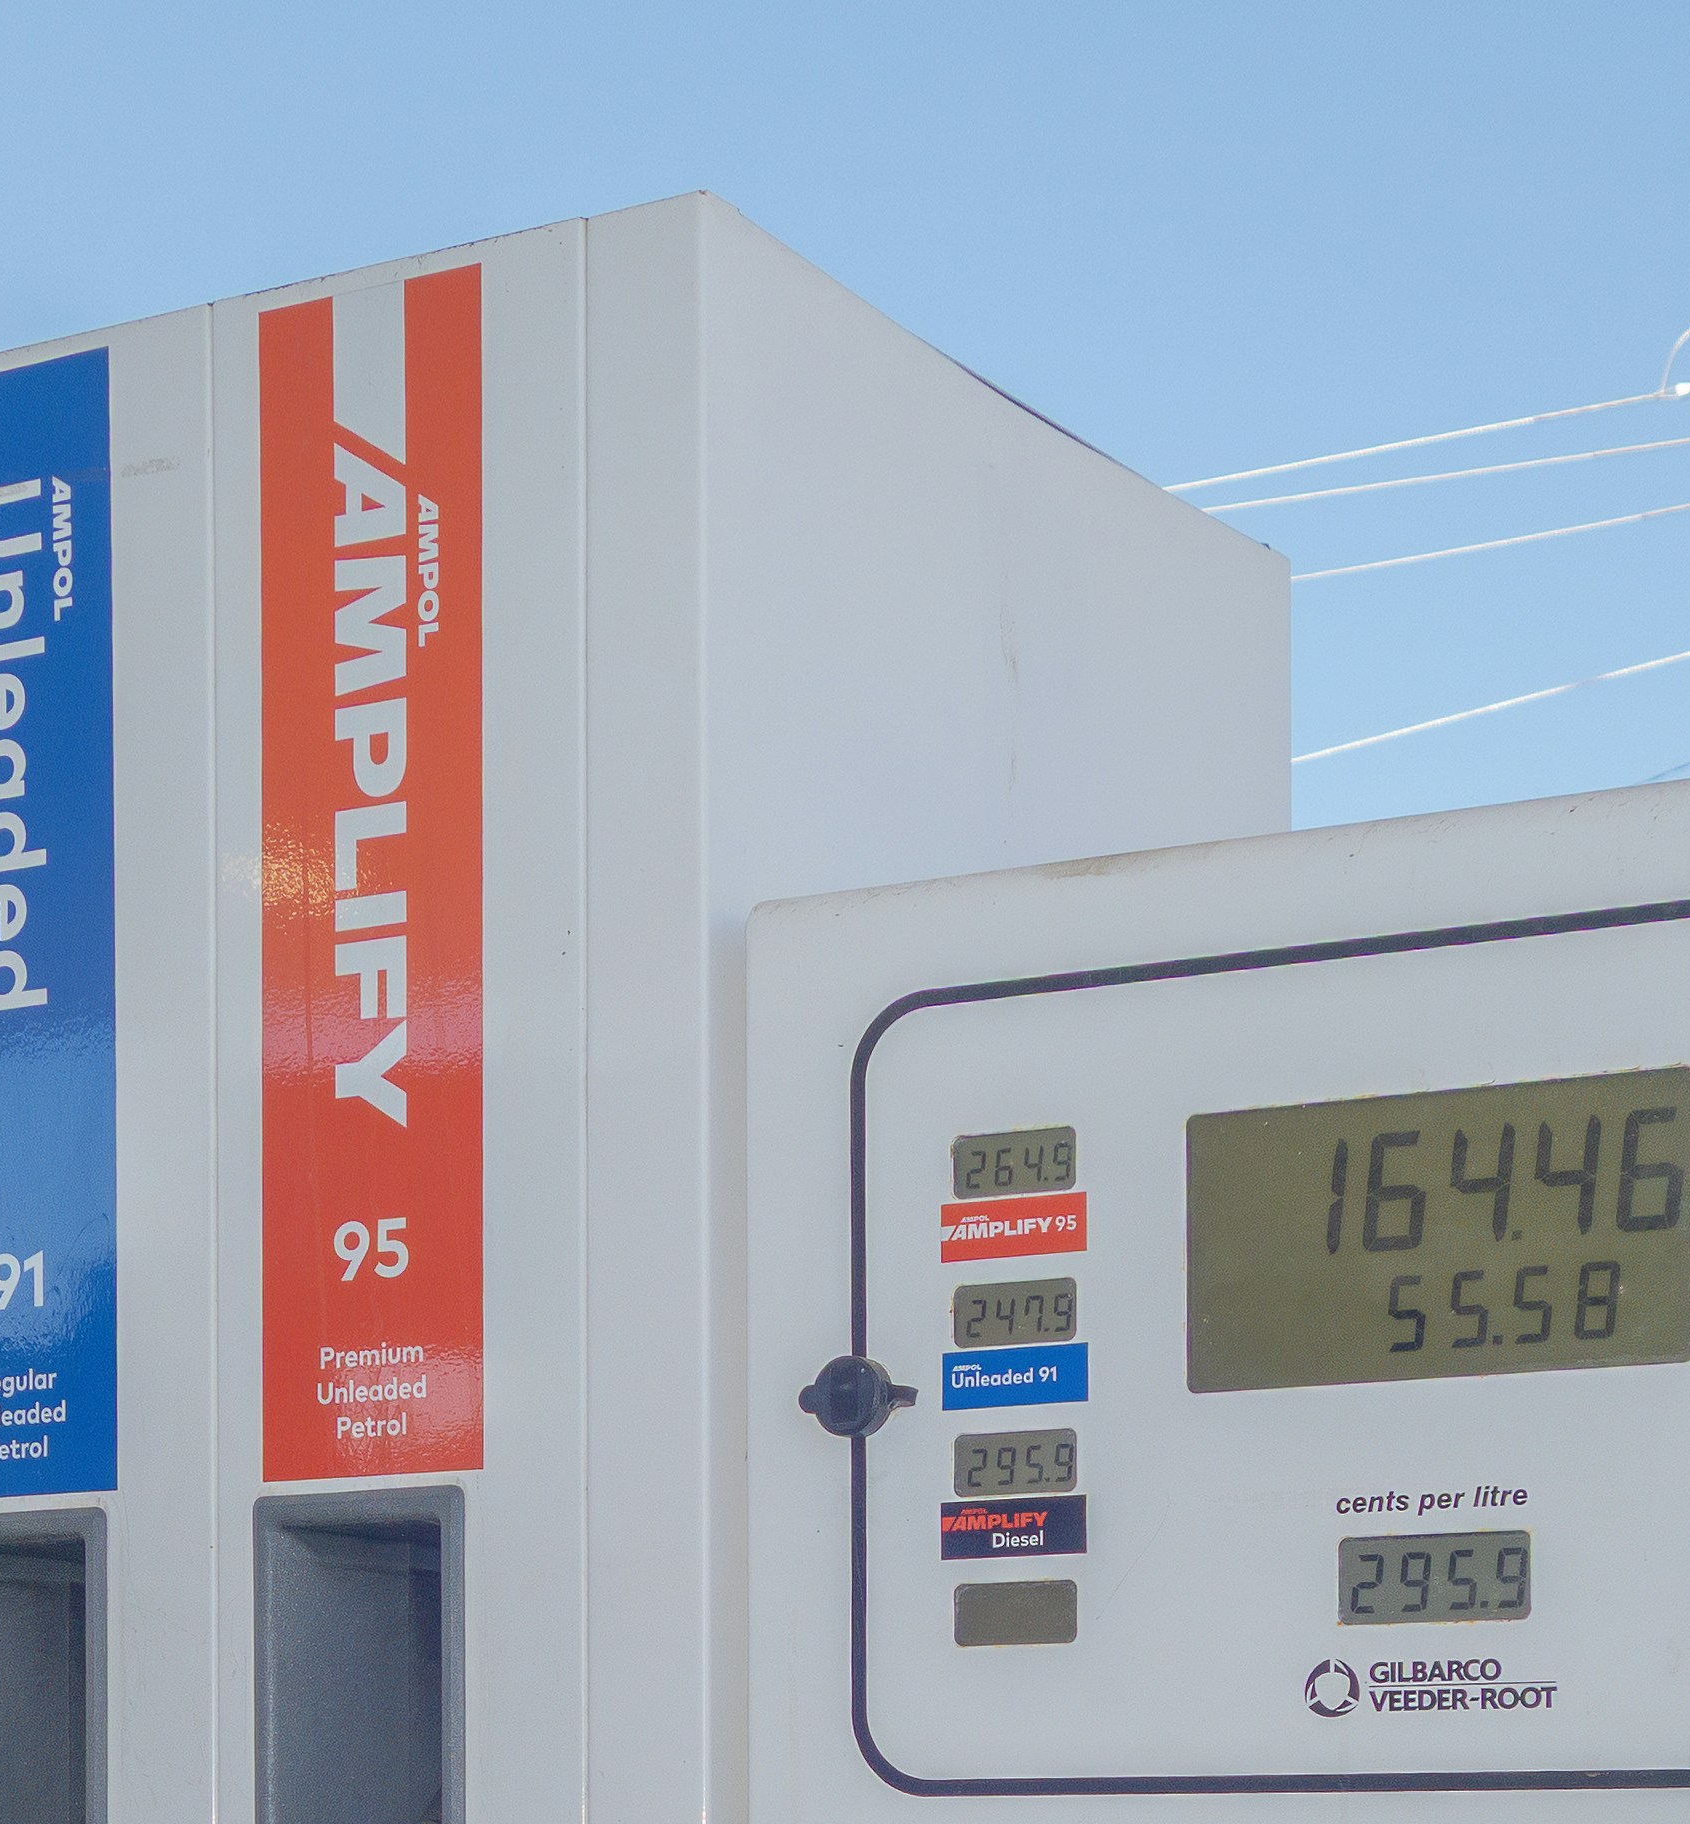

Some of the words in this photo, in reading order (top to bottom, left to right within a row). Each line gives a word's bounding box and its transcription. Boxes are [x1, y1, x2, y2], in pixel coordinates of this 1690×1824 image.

[52, 476, 74, 622] AMPOL
[417, 494, 440, 648] AMPOL
[334, 443, 408, 1130] AMPLIFY
[966, 1141, 1072, 1190] 264.9
[1327, 1106, 1685, 1255] 164.46
[952, 1217, 1053, 1241] AMPLIFY
[1056, 1215, 1077, 1232] 95
[334, 1217, 409, 1282] 95
[966, 1293, 1072, 1339] 247.9
[1388, 1260, 1621, 1353] 55.58
[320, 1342, 424, 1370] Premium
[317, 1374, 427, 1405] Unleaded
[952, 1367, 1034, 1389] Unleaded
[1039, 1366, 1057, 1383] 91
[337, 1413, 407, 1439] Petrol
[967, 1444, 1074, 1487] 295.9
[1336, 1491, 1409, 1514] cents
[1418, 1493, 1465, 1516] per
[1473, 1486, 1528, 1508] litre
[951, 1511, 1048, 1531] AMPLIFY
[992, 1530, 1044, 1549] Diesel
[1350, 1547, 1527, 1614] 295.9
[1369, 1659, 1502, 1683] GILBARCO
[1369, 1686, 1558, 1712] VEEDER-ROOT
